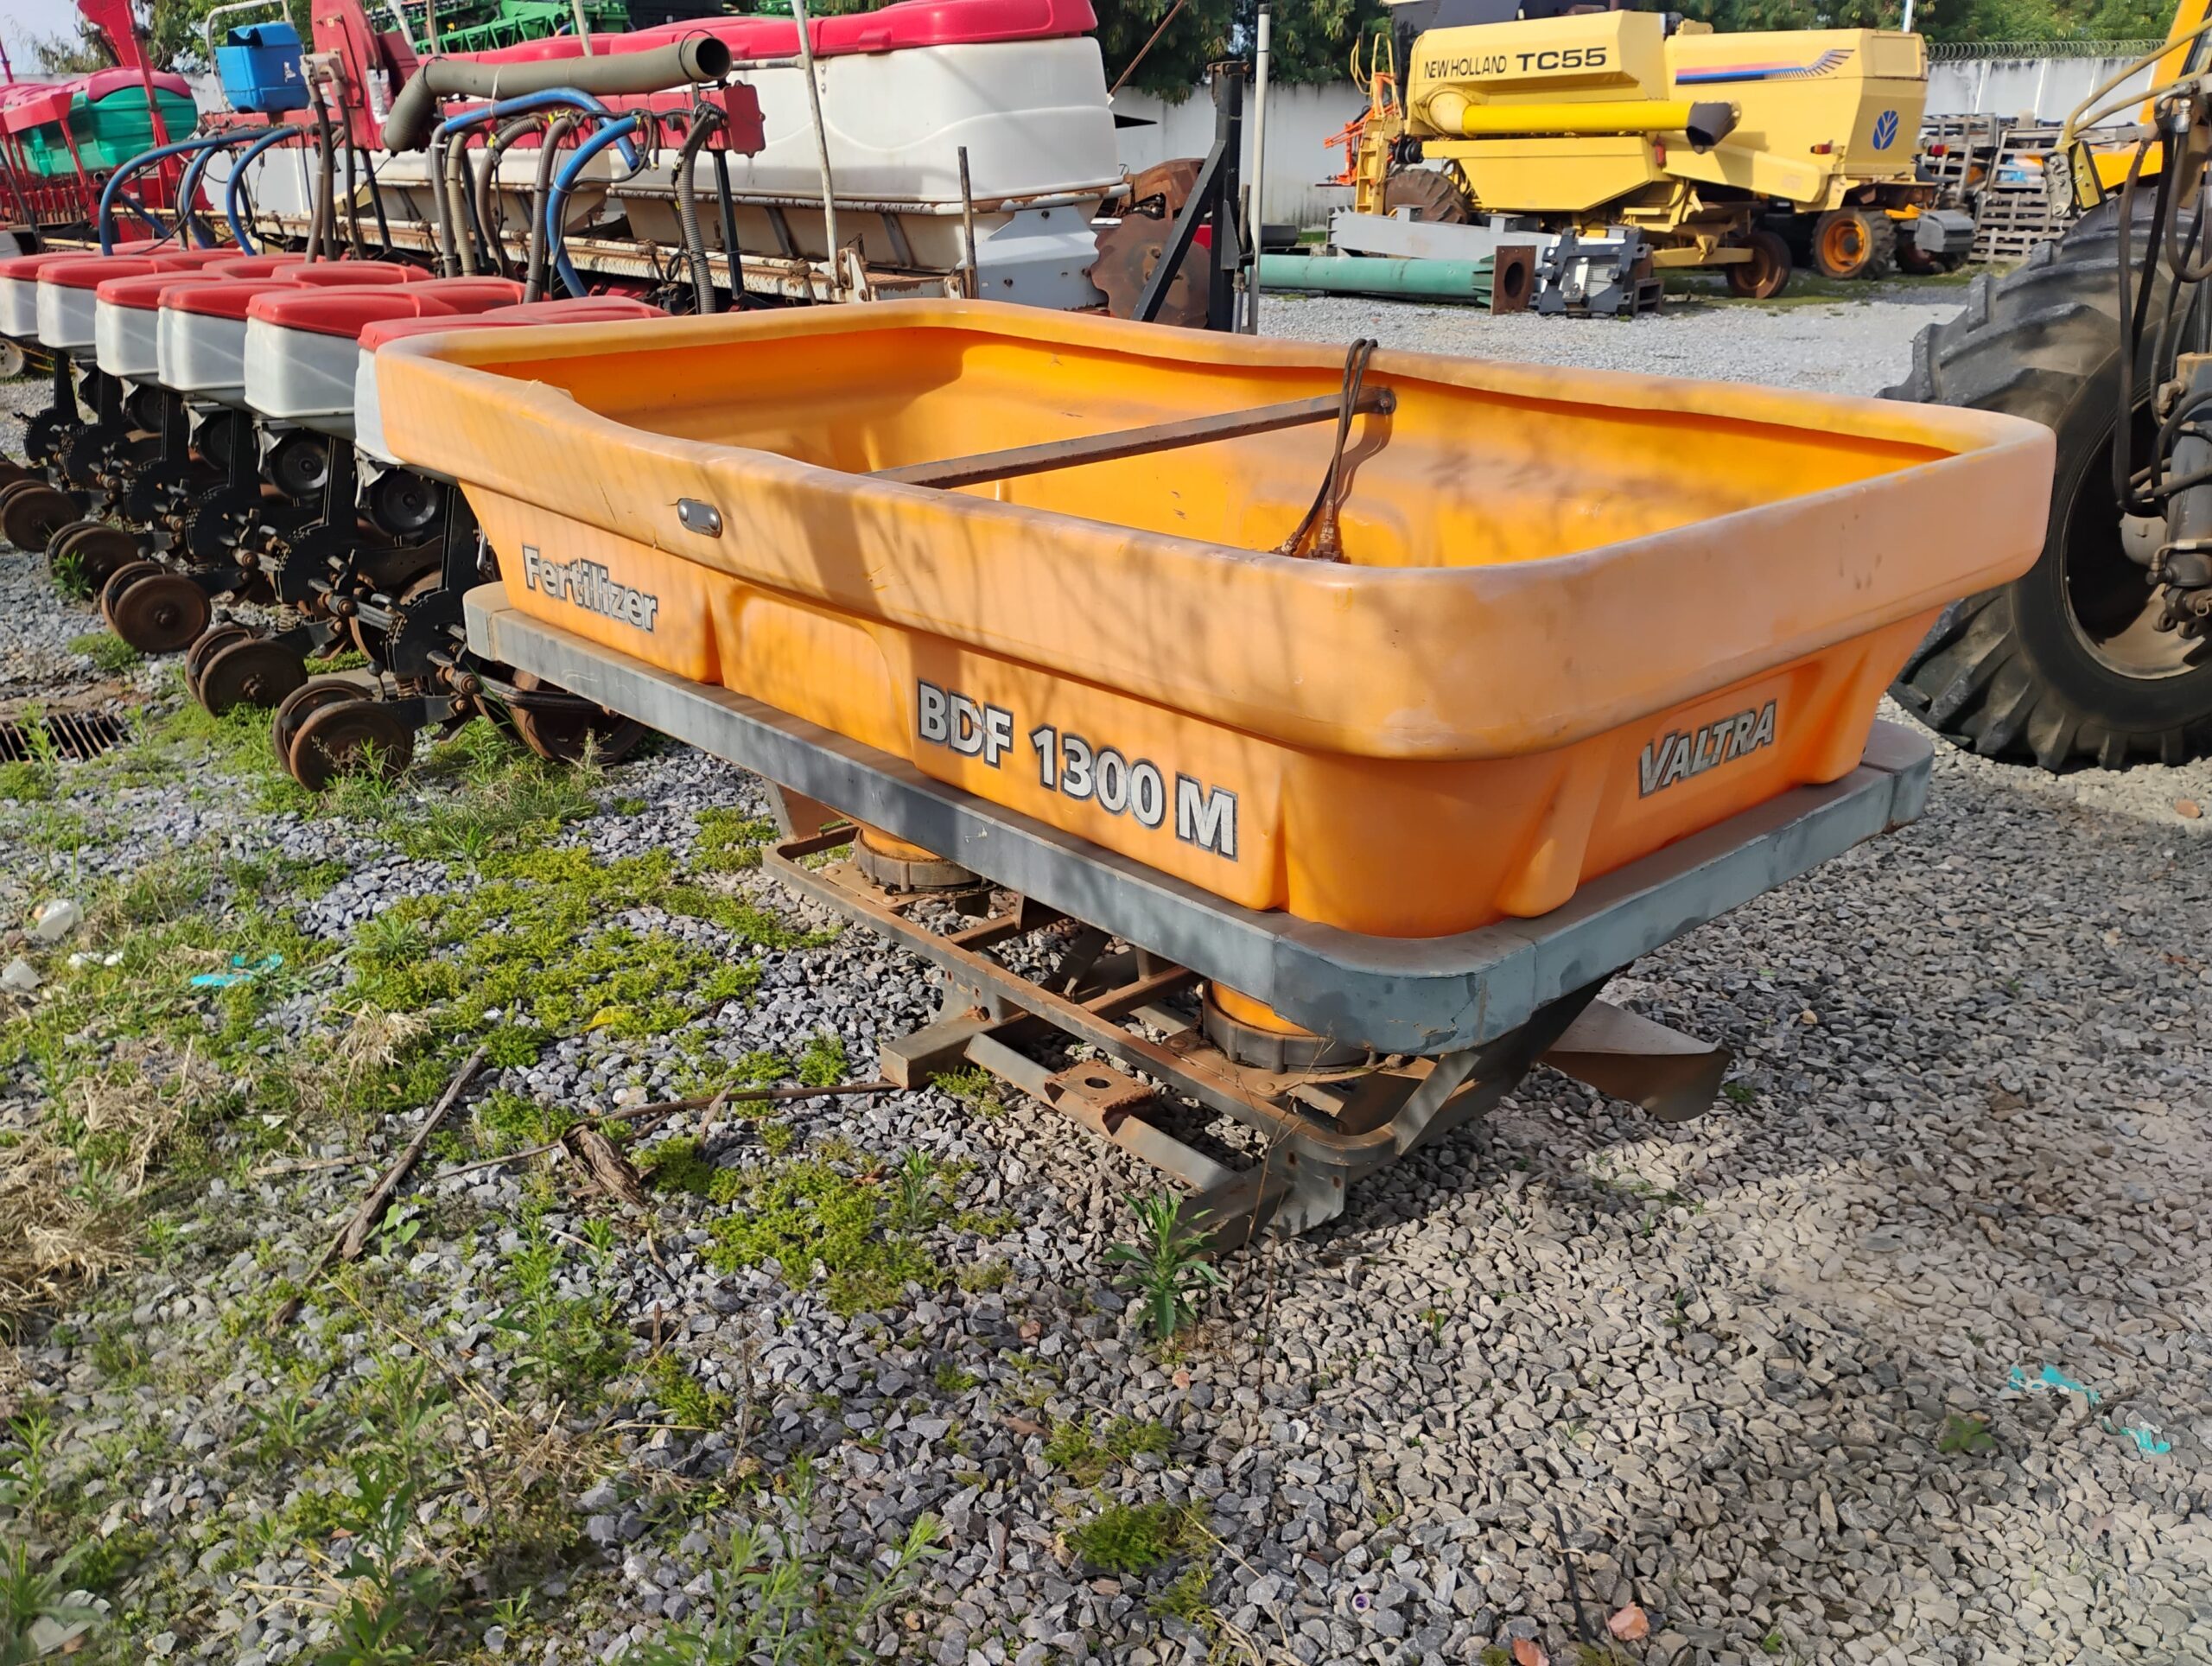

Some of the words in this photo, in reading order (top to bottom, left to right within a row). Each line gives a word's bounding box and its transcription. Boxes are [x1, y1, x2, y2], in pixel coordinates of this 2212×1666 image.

[1424, 60, 1450, 79] NEW
[1451, 55, 1507, 77] HOLLAND
[1516, 47, 1607, 72] TC55
[522, 544, 658, 633] Fertilizer
[918, 678, 1014, 769] BDF
[1029, 723, 1166, 830] 1300
[1175, 772, 1238, 862] M
[1639, 698, 1777, 798] VALTRA
